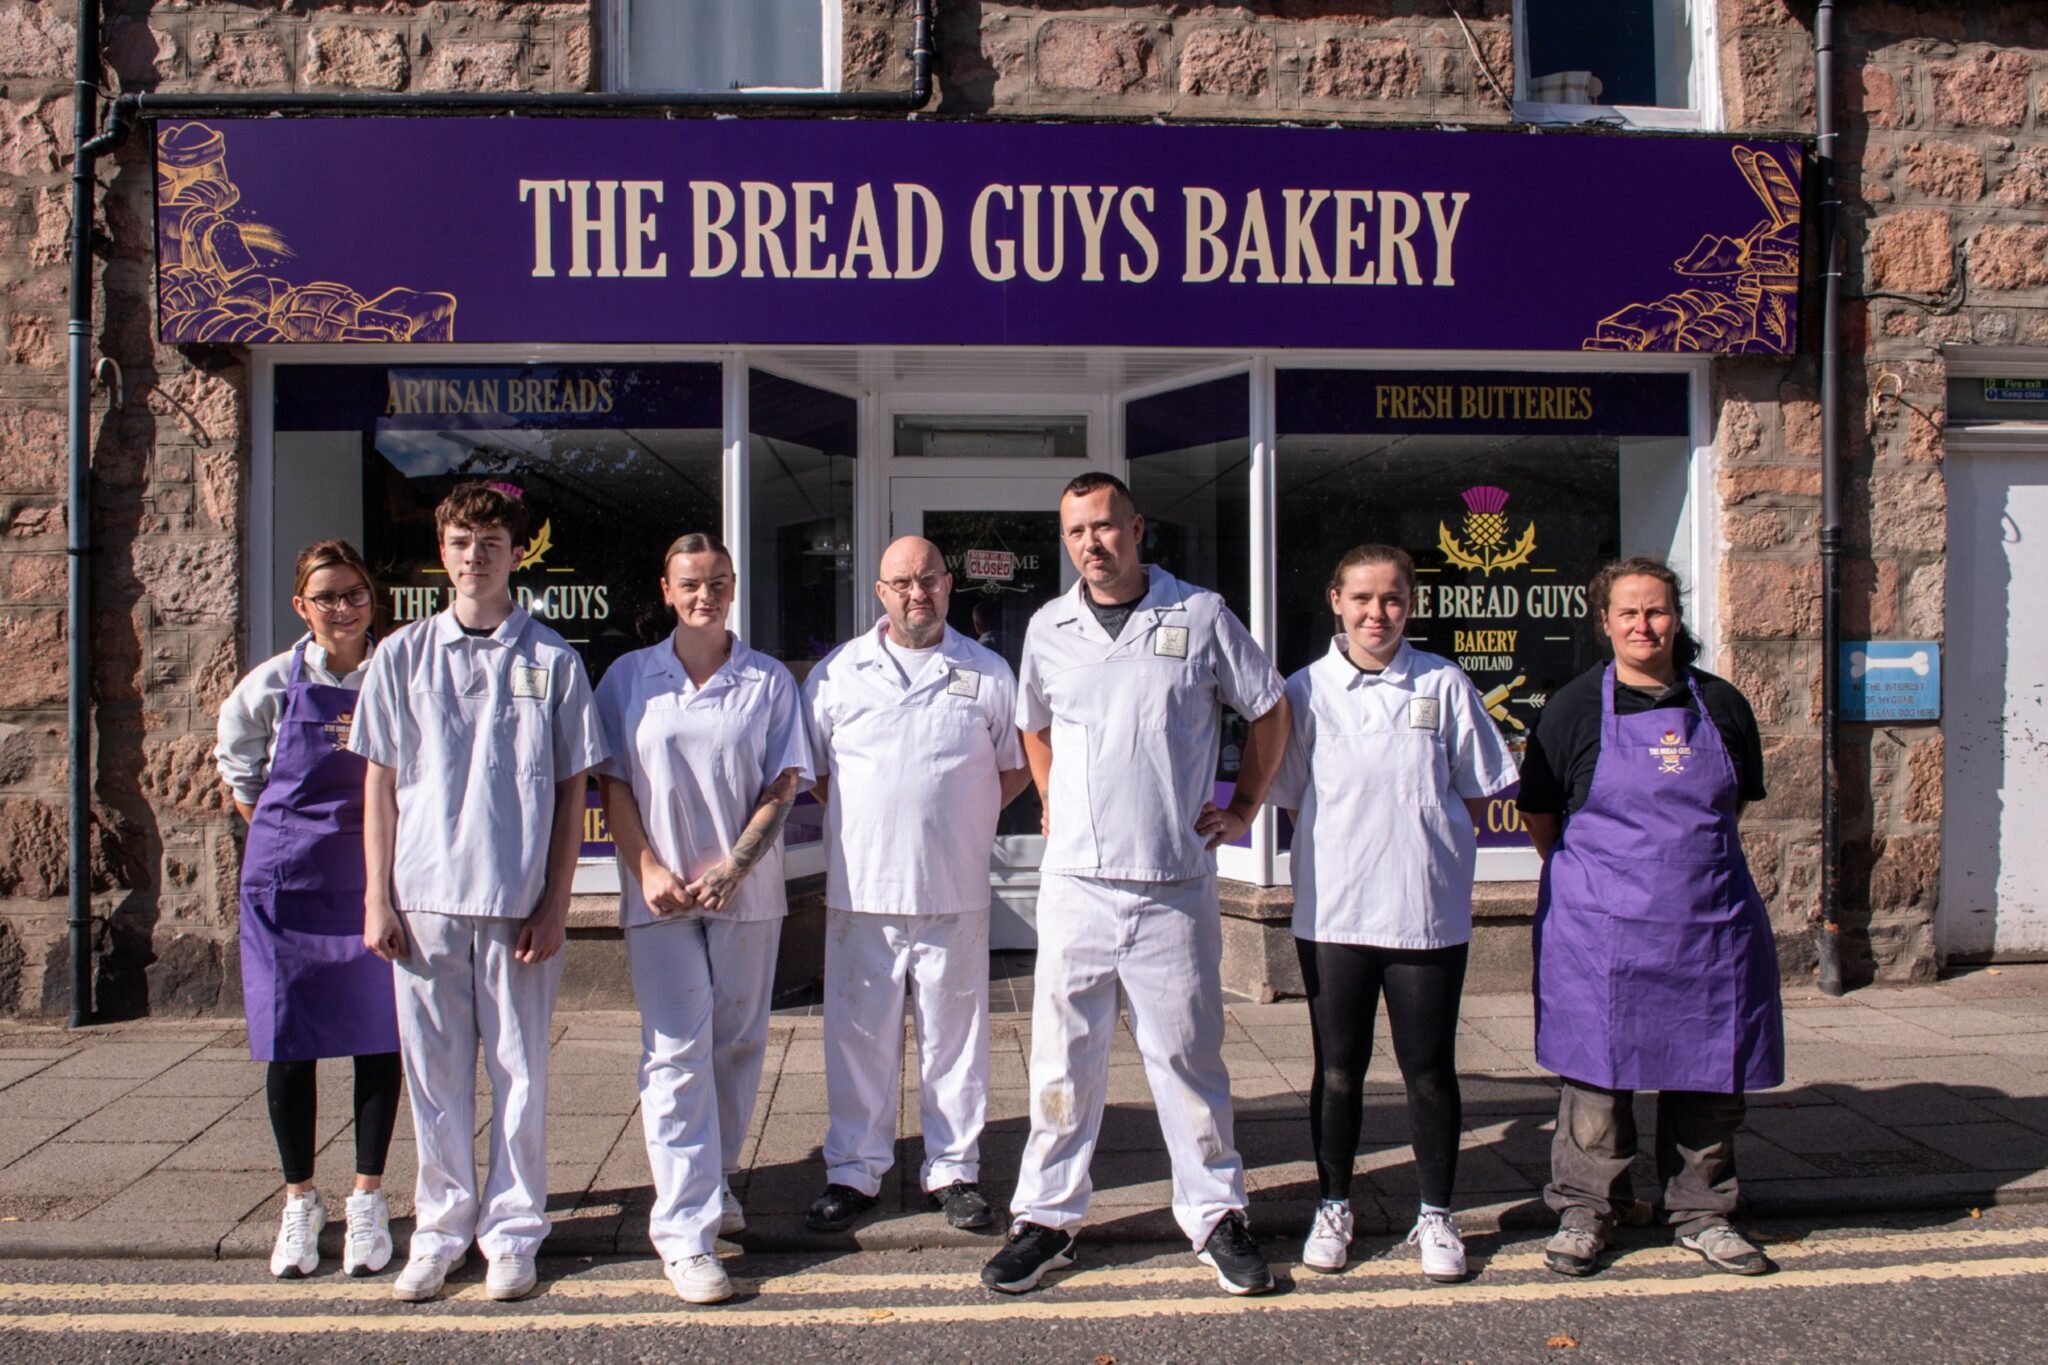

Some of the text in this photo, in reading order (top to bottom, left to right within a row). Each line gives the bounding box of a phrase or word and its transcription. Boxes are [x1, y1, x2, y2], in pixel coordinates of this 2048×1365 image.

[519, 179, 1470, 286] THE BREAD GUYS BAKERY
[2004, 379, 2042, 388] Fire exit
[385, 378, 613, 415] ARTISAN BREADS
[1375, 385, 1593, 421] FRESH BUTTERIES
[2002, 389, 2045, 400] Keep clear
[970, 560, 1010, 576] CLOSED
[543, 585, 609, 620] GUYS
[1438, 585, 1519, 618] BREAD
[1526, 585, 1588, 618] GUYS
[1454, 630, 1518, 652] BAKERY
[1458, 655, 1513, 671] SCOTLAND
[1867, 682, 1880, 691] THE
[1885, 682, 1924, 691] INTEREST
[1879, 695, 1914, 704] HYGIENE
